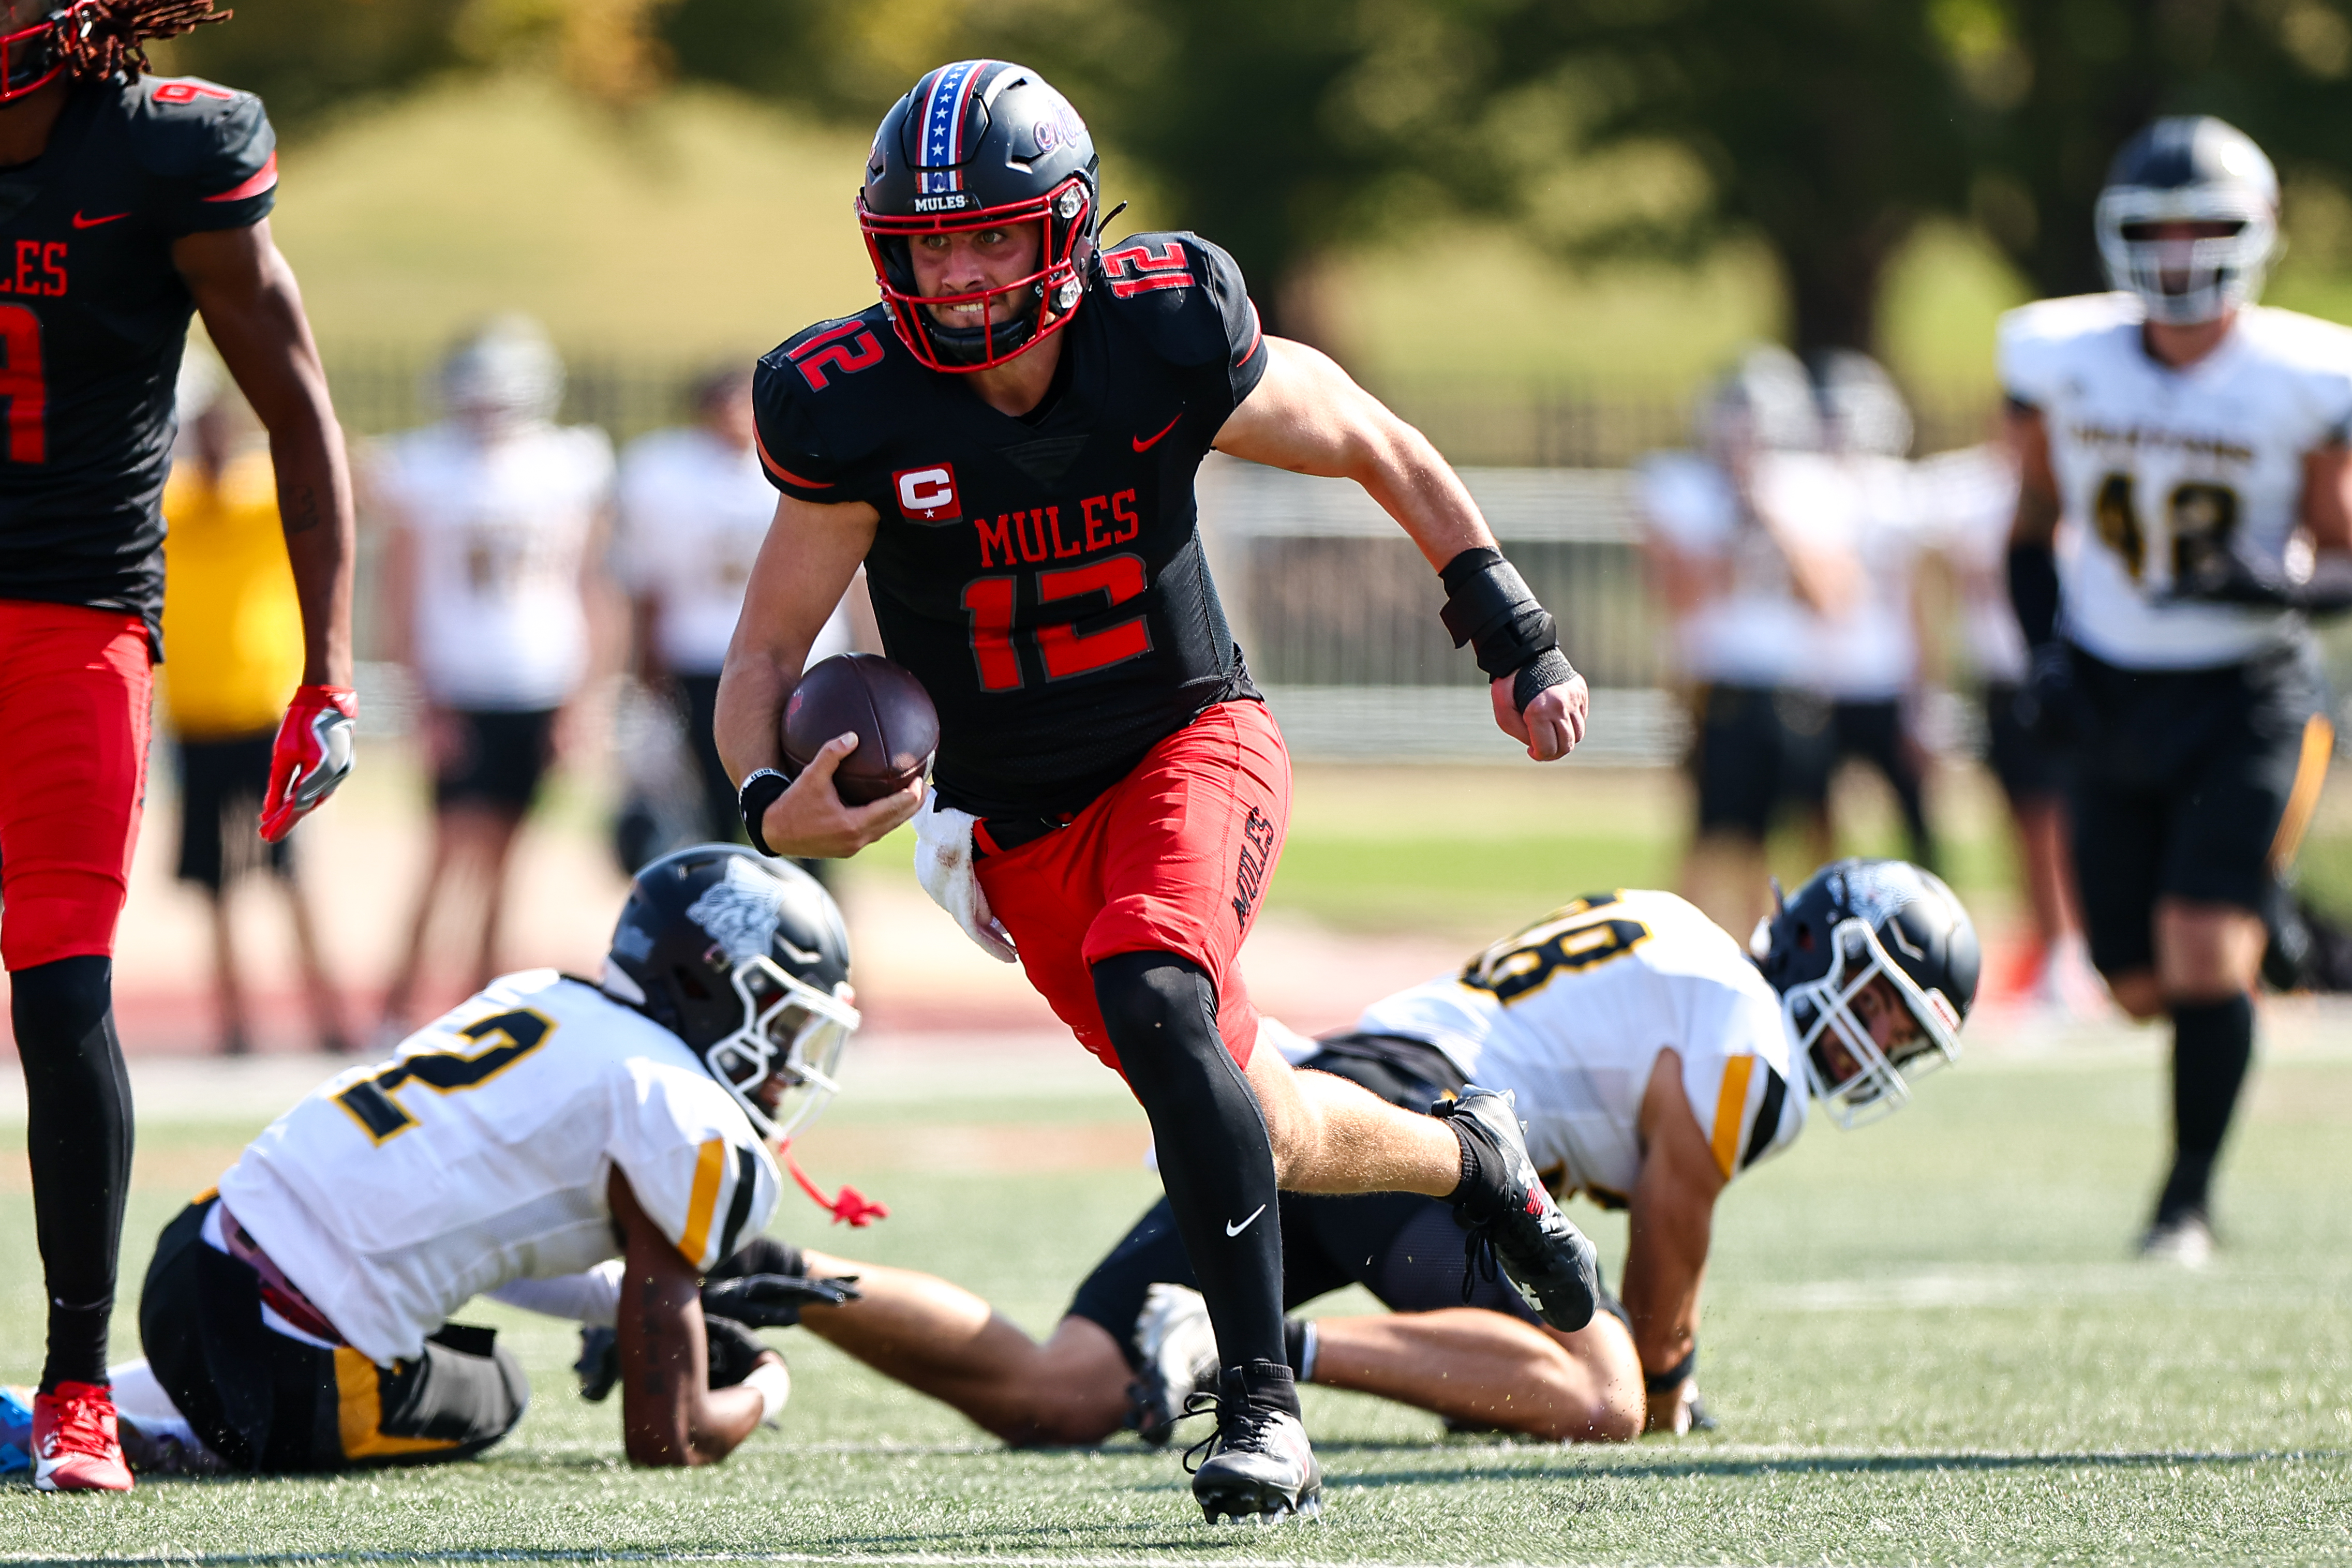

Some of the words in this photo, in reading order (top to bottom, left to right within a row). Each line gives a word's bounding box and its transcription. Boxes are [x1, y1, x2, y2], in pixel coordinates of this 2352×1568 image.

[152, 81, 237, 103] 9
[915, 195, 966, 212] MULES
[1101, 243, 1196, 300] 12
[787, 319, 885, 393] 12
[899, 468, 952, 510] C
[974, 488, 1138, 568] MULES
[959, 552, 1153, 693] 12
[1232, 807, 1274, 934] MULES
[328, 1006, 560, 1148] 2
